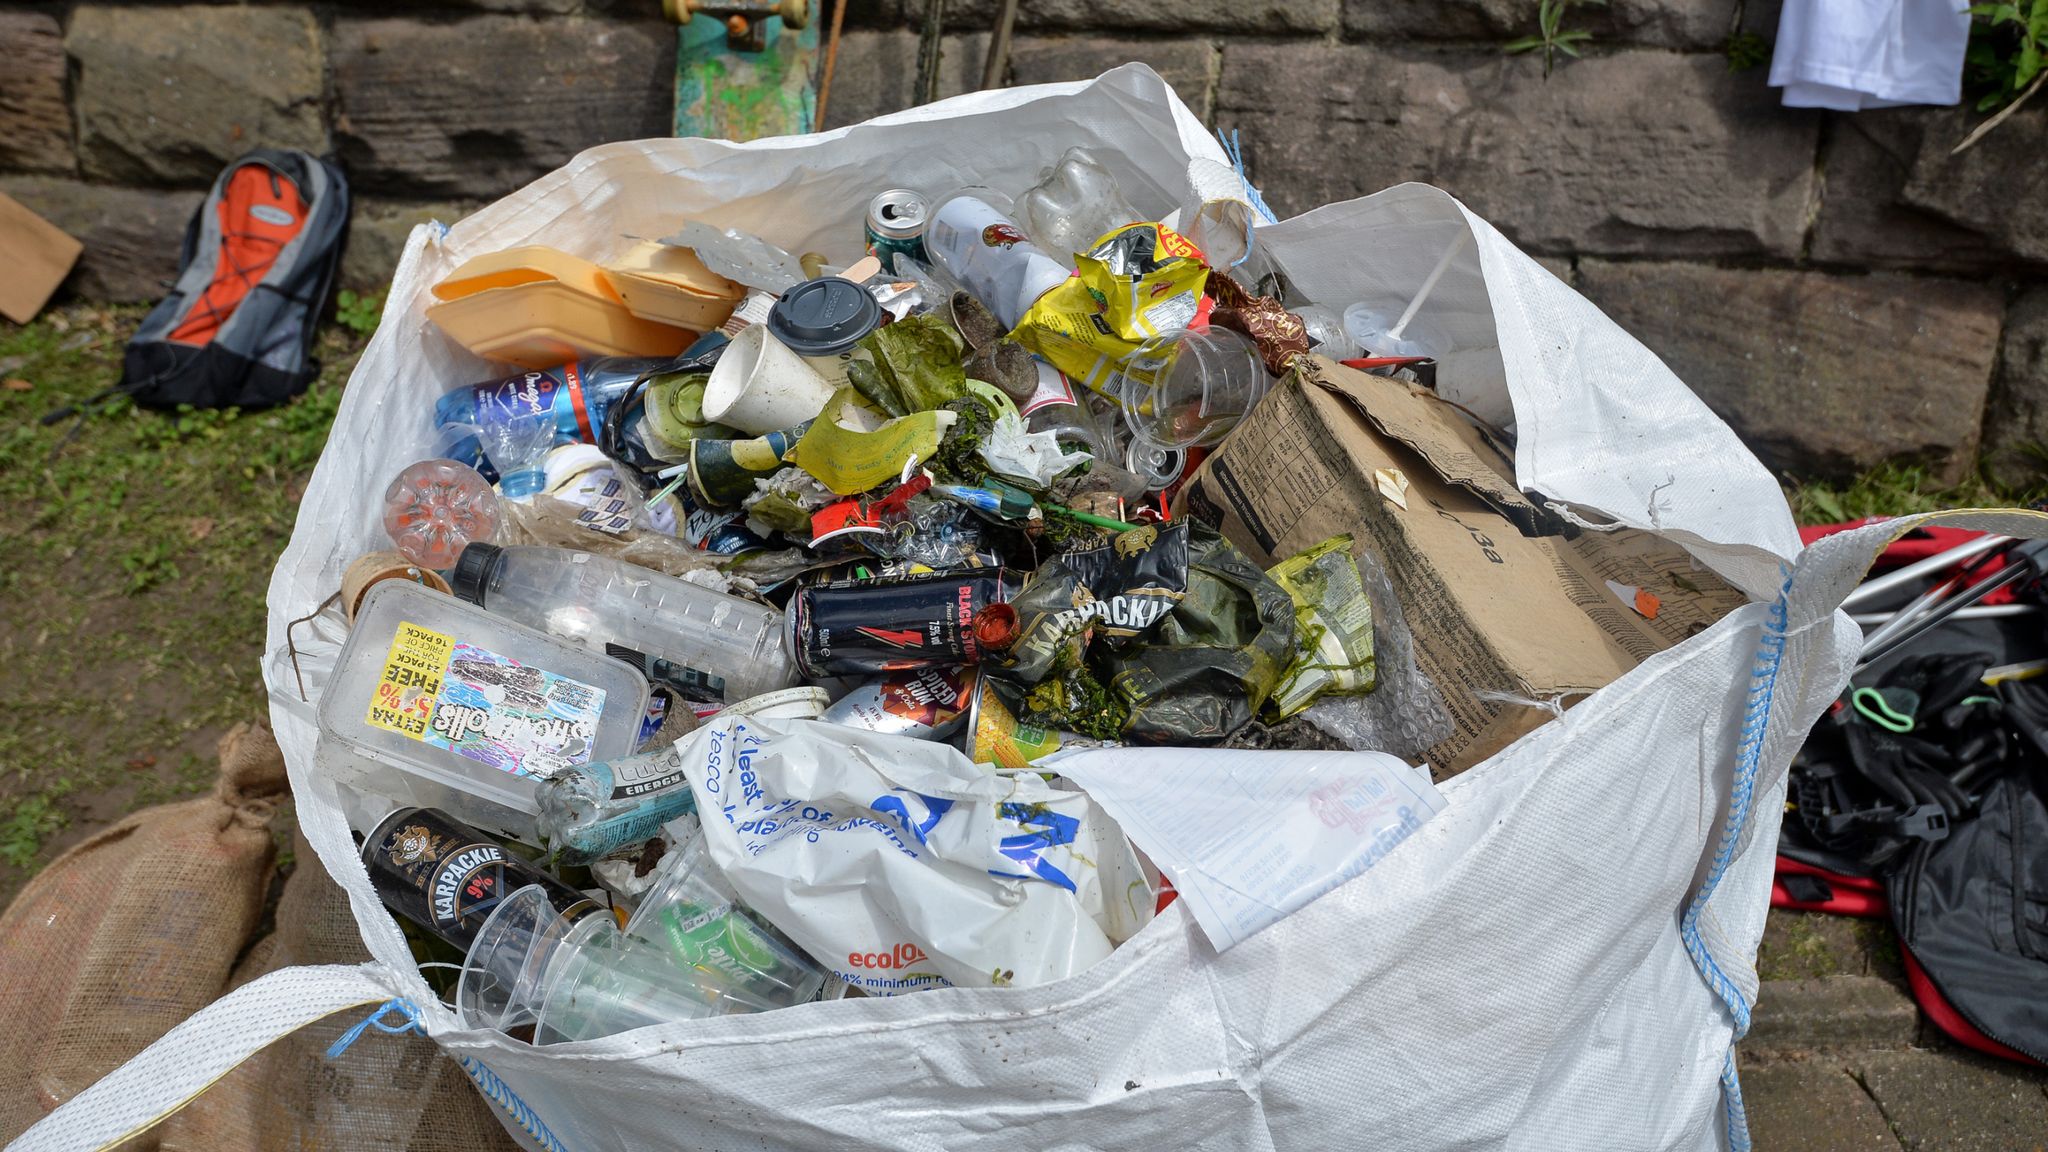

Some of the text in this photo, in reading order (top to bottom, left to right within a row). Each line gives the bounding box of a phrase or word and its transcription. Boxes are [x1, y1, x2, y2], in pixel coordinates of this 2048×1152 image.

[946, 601, 954, 621] Finest
[958, 585, 974, 628] BLACK
[404, 636, 444, 655] PRICE OF
[405, 626, 448, 646] 16 PACK
[930, 635, 943, 646] vol
[395, 652, 425, 668] PACK
[420, 650, 440, 663] FOR
[1421, 658, 1437, 676] packs
[383, 662, 440, 695] FREE
[917, 668, 958, 706] SPICED
[901, 693, 916, 710] Cola
[905, 680, 935, 706] RUM
[1442, 683, 1461, 705] remove
[369, 704, 425, 735] EXTRA
[705, 730, 727, 794] tesco
[625, 774, 681, 796] ENERGY
[738, 748, 765, 806] least
[435, 847, 502, 921] KARPACKIE
[466, 874, 494, 899] 9%
[866, 975, 931, 989] minimum
